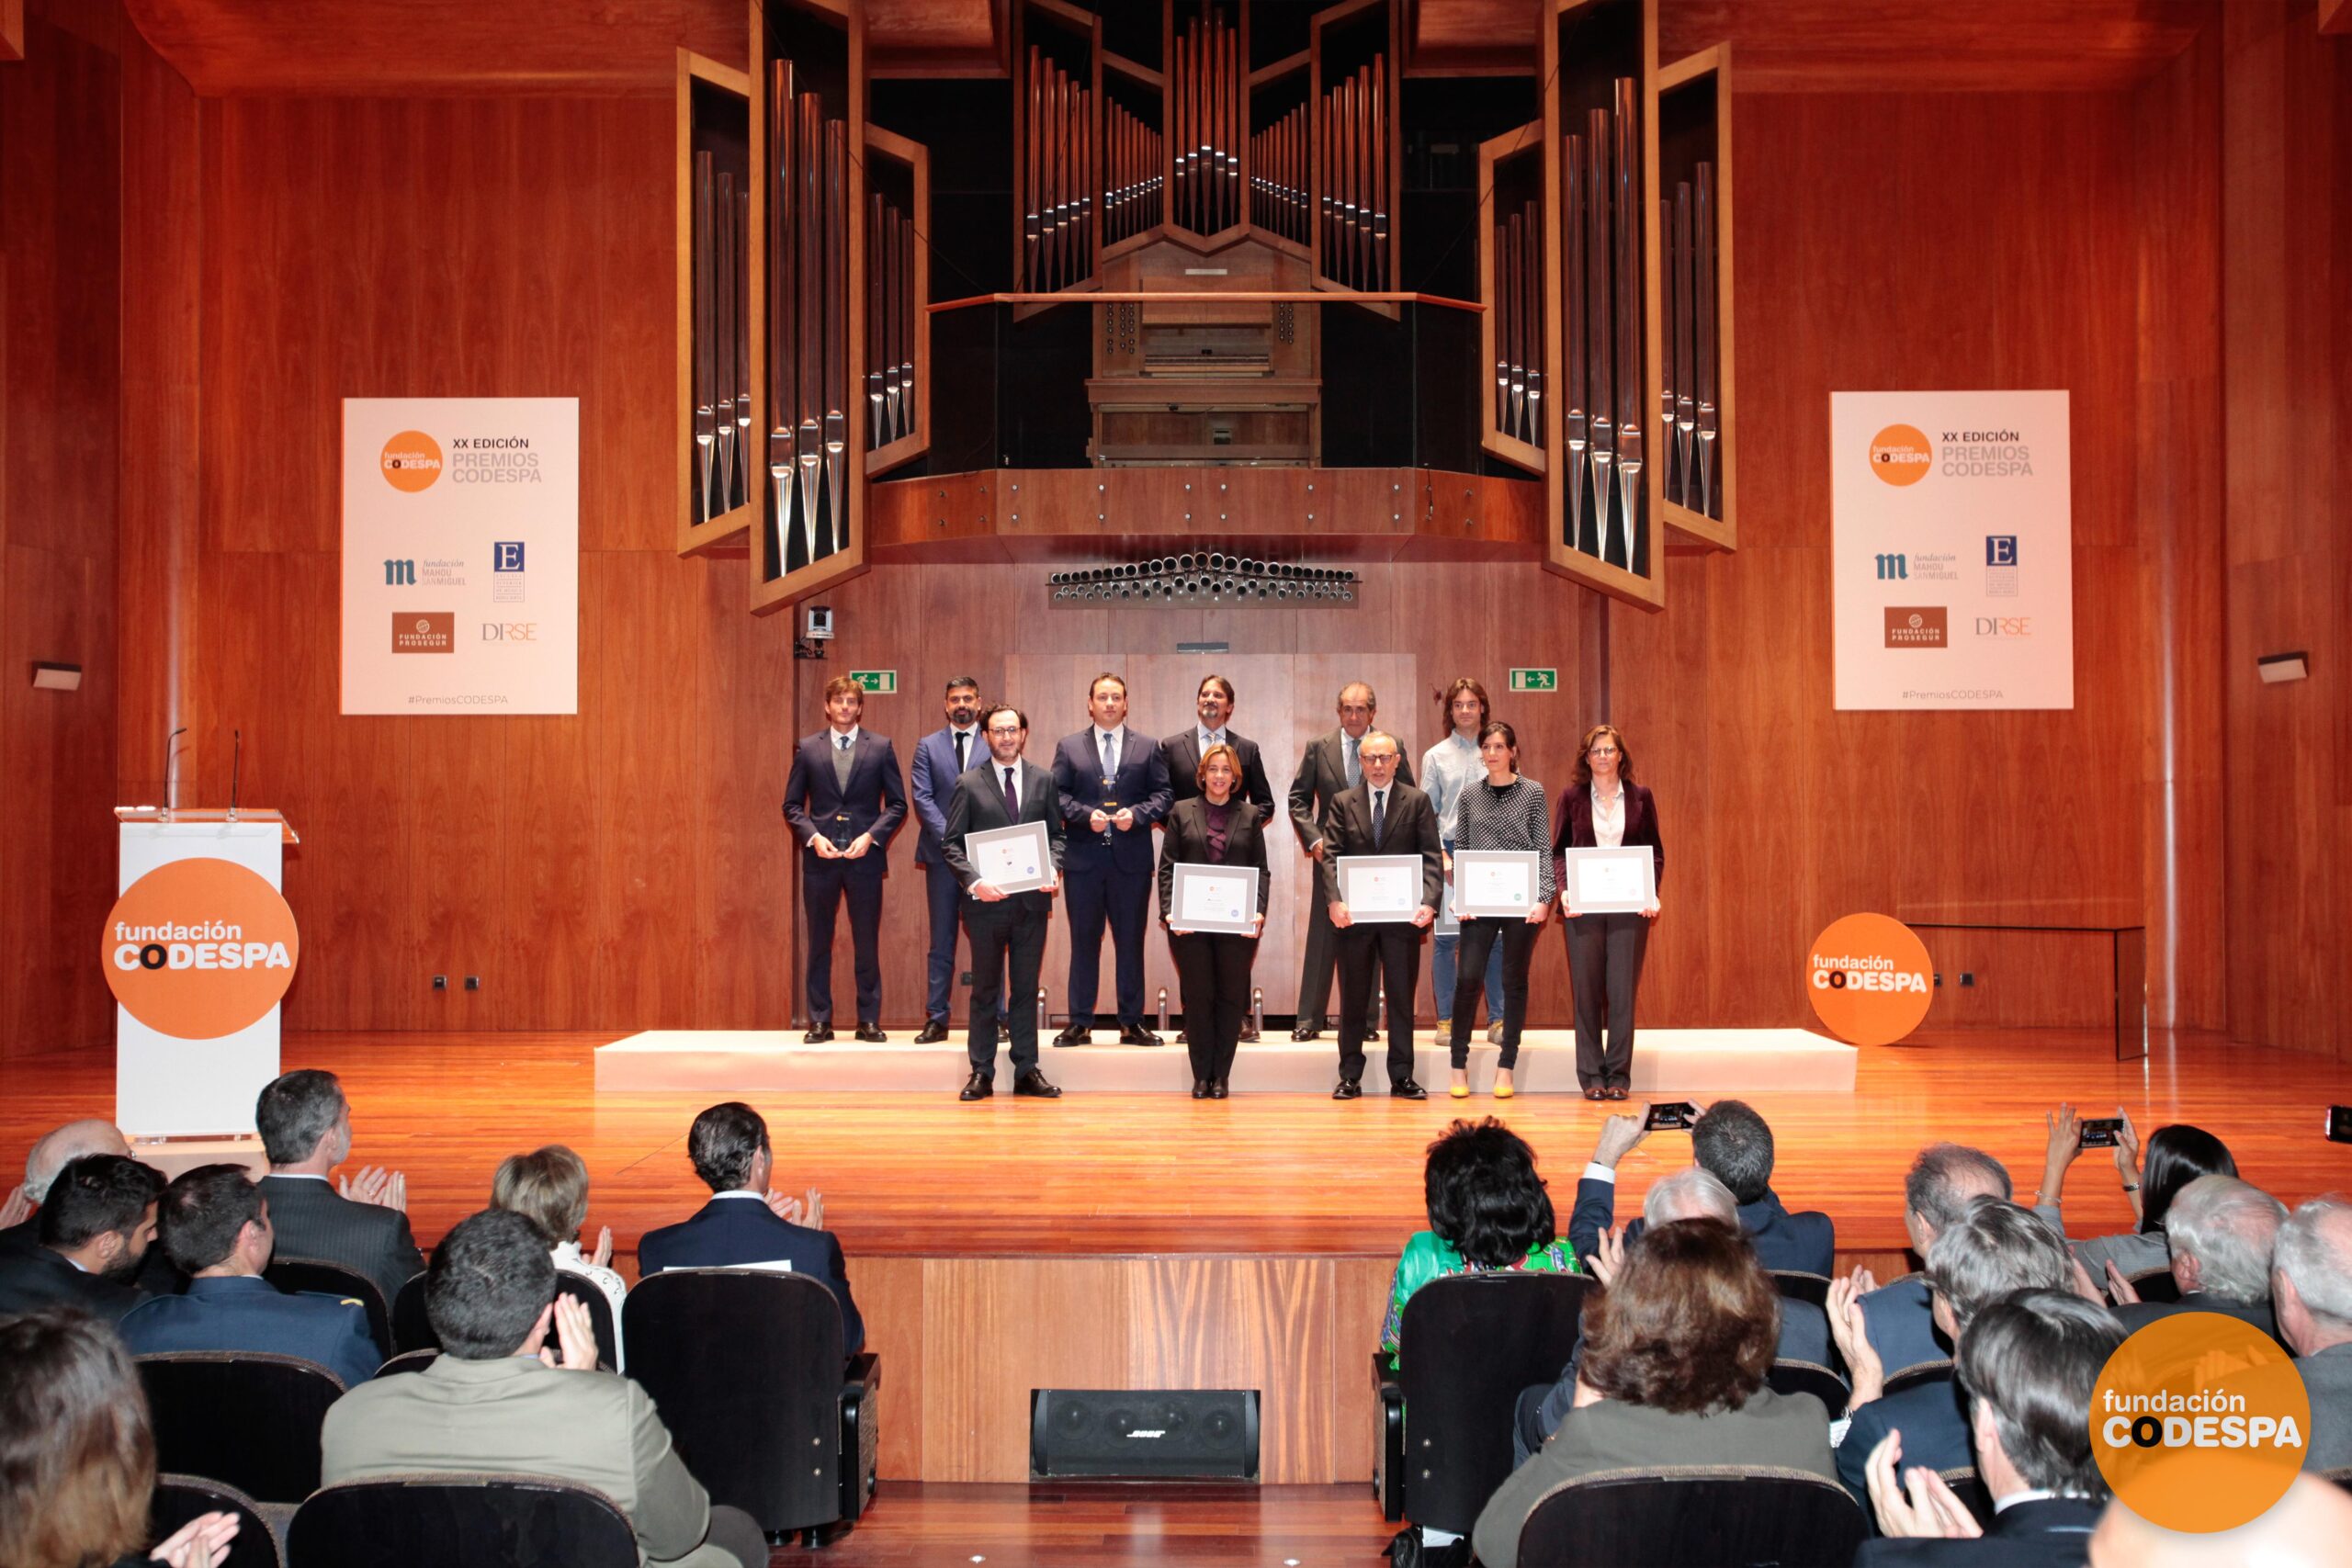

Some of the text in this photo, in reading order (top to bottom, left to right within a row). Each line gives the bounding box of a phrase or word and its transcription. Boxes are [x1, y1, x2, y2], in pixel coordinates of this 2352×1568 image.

[453, 435, 529, 449] XX EDICIÓN
[1942, 429, 2019, 442] XX EDICIÓN
[384, 451, 425, 459] fundación
[1872, 446, 1914, 454] fundación
[1942, 446, 2030, 461] PREMIOS
[384, 459, 440, 469] CODESPA
[452, 452, 538, 468] PREMIOS
[1872, 453, 1929, 463] CODESPA
[452, 468, 542, 483] CODESPA
[1942, 461, 2033, 477] CODESPA
[481, 623, 537, 641] DIRSE
[1975, 617, 2031, 635] DIRSE
[408, 694, 508, 705] #PremiosCODESPA
[1902, 689, 2004, 699] #PremiosCODESPA
[114, 919, 242, 941] fundación
[113, 942, 291, 971] CODESPA
[1813, 953, 1894, 970] fundación
[1813, 969, 1927, 993] CODESPA
